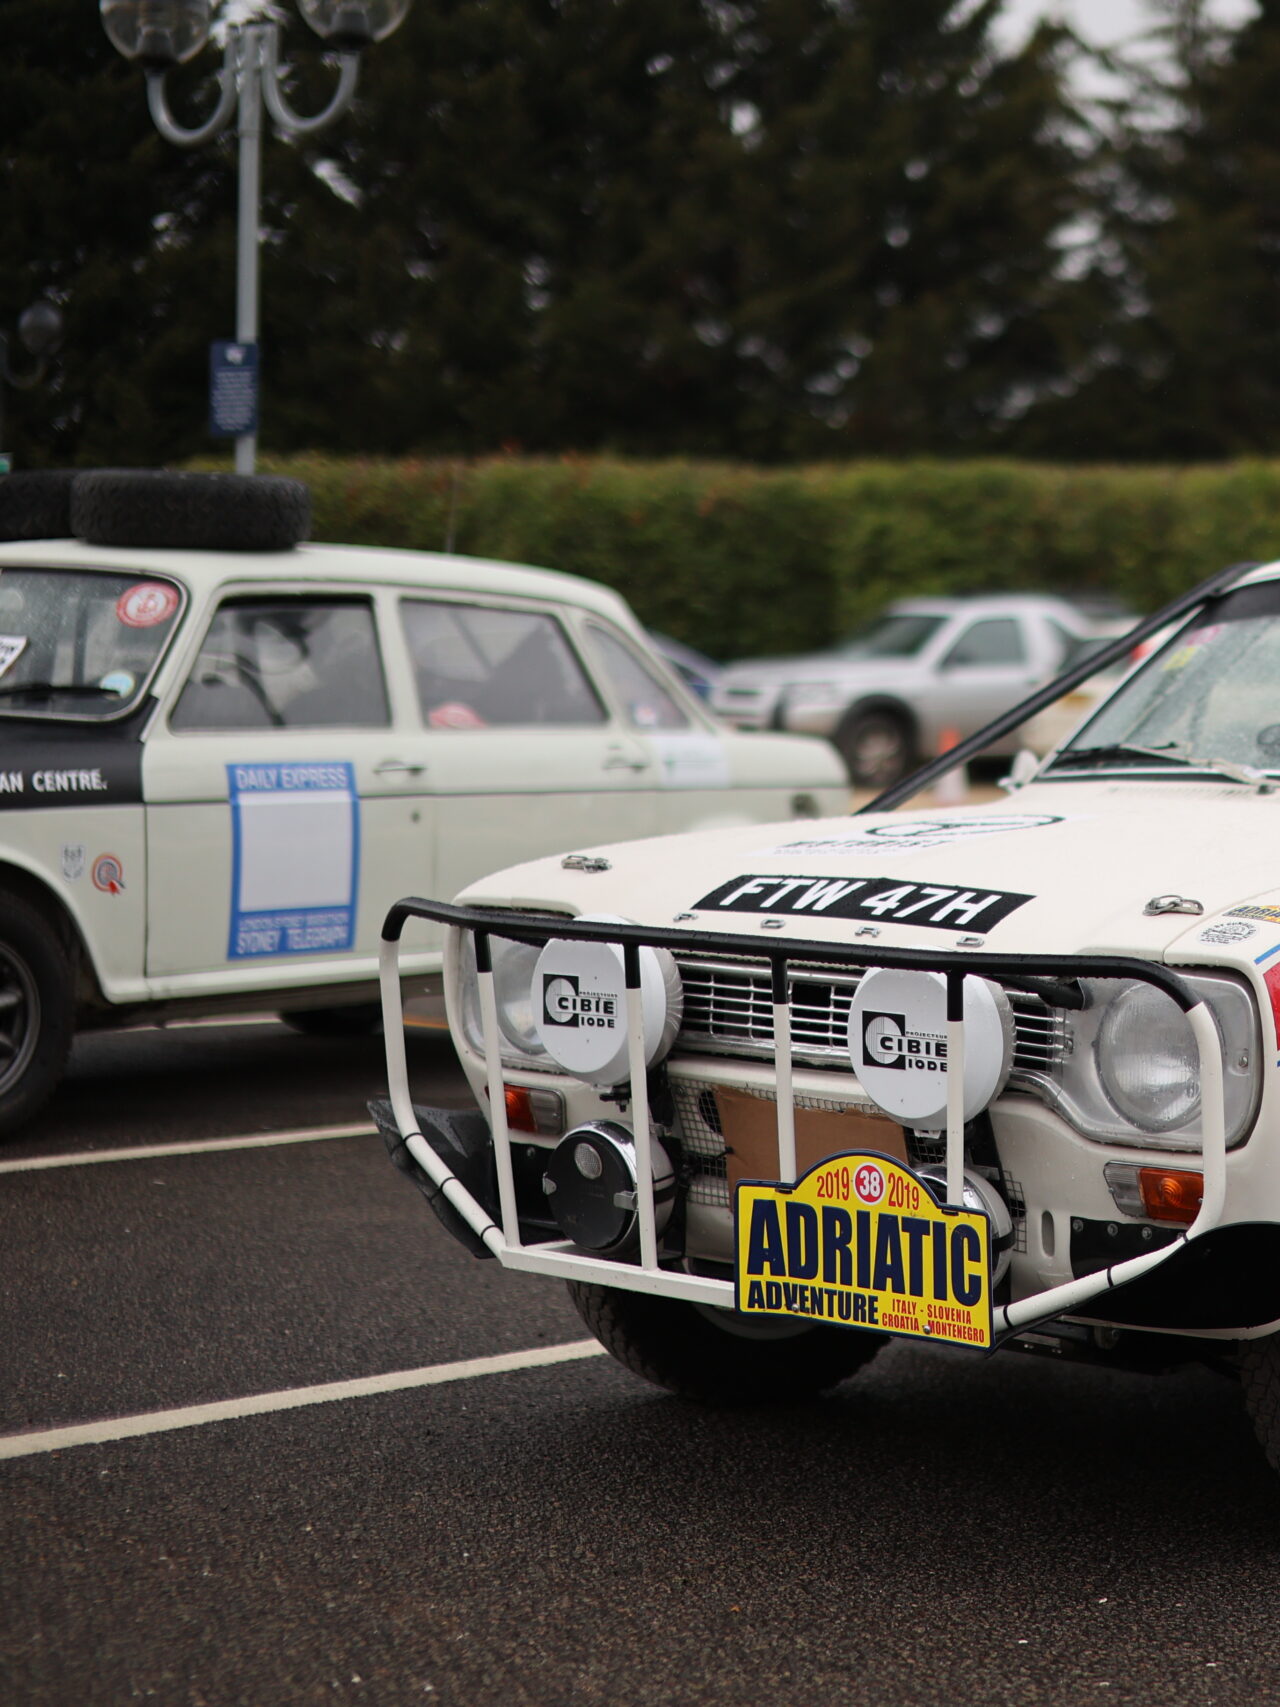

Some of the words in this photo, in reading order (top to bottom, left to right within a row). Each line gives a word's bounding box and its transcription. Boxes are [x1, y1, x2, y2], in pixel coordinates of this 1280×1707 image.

[236, 767, 277, 790] DAILY
[281, 766, 348, 788] EXPRESS
[719, 877, 868, 911] FTW
[859, 884, 1003, 926] 47H
[236, 930, 281, 955] SYDNEY
[672, 911, 985, 949] FORD
[580, 1016, 615, 1029] IODE
[905, 1030, 948, 1040] PROJECTEUR
[908, 1058, 948, 1073] IODE
[816, 1166, 850, 1202] 2019
[859, 1169, 881, 1198] 38
[887, 1172, 920, 1211] 2019
[746, 1198, 982, 1307] ADRIATIC
[747, 1280, 879, 1325] ADVENTURE
[892, 1298, 917, 1316] ITALY
[927, 1303, 972, 1325] SLOVENIA
[882, 1312, 920, 1332] CROATIA
[926, 1319, 985, 1343] MONTENEGRO
